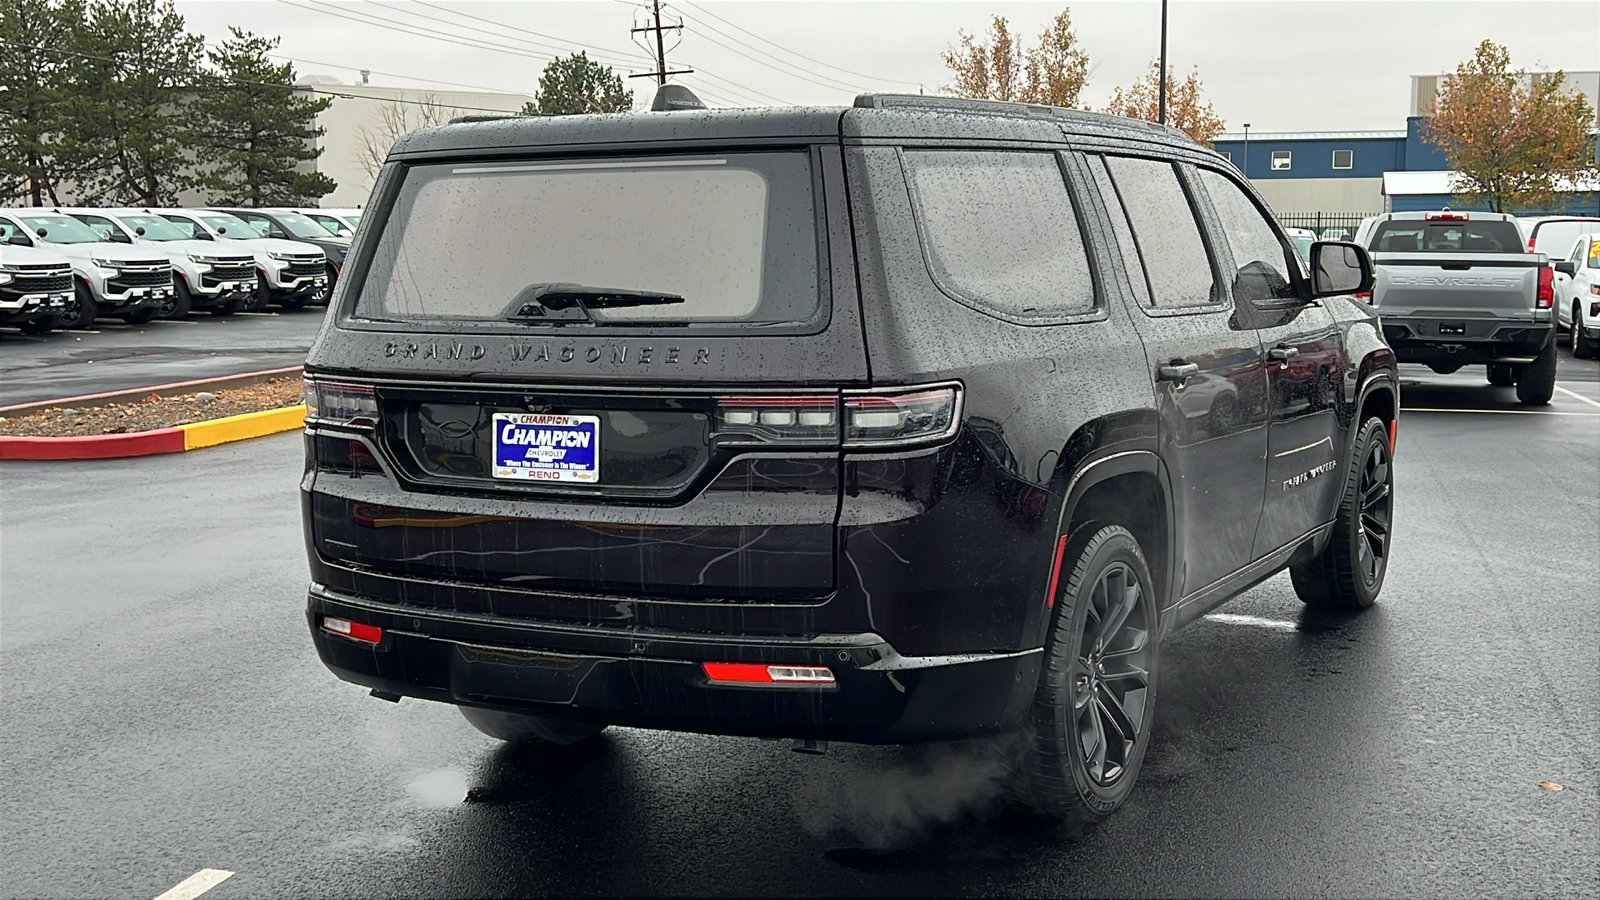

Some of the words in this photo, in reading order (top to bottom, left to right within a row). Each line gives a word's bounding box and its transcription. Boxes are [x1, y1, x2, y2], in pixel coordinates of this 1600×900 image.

[1391, 276, 1521, 288] CHEVROLET
[384, 342, 486, 361] GRAND
[509, 344, 709, 365] WAGONEER
[520, 415, 570, 425] CHAMPION
[502, 424, 591, 448] CHAMPION
[528, 449, 563, 458] CHEVROLET
[528, 470, 561, 479] RENO
